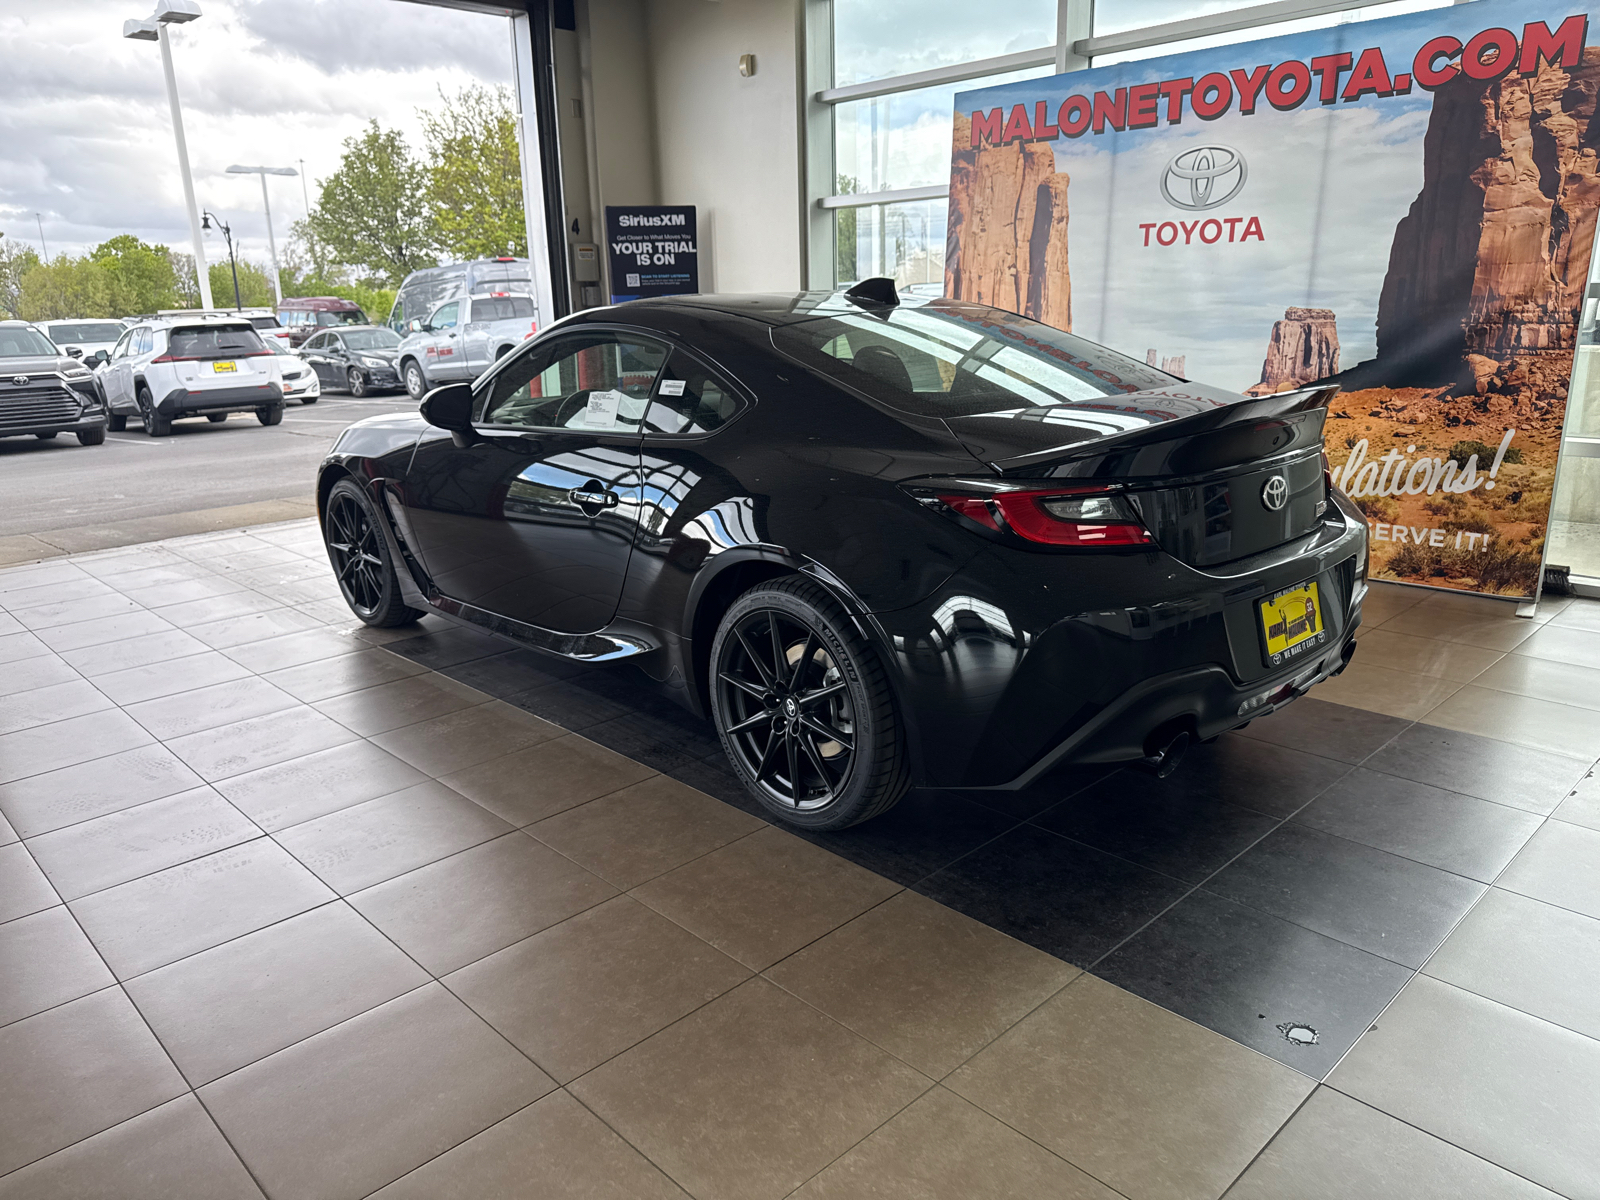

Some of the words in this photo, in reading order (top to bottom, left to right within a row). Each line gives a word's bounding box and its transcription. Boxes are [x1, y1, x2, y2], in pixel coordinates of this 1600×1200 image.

[971, 13, 1588, 148] MALONETOYOTA.COM
[619, 214, 686, 227] SiriusXM
[1139, 216, 1266, 248] TOYOTA
[612, 242, 653, 255] YOUR
[655, 241, 697, 253] TRIAL
[636, 254, 651, 266] IS
[653, 254, 675, 266] ON
[1454, 532, 1489, 553] IT!
[1306, 601, 1313, 612] 32
[824, 628, 858, 681] MICHELIN
[1283, 649, 1291, 659] WE
[1291, 645, 1302, 656] MAKE
[1306, 637, 1317, 648] EASY
